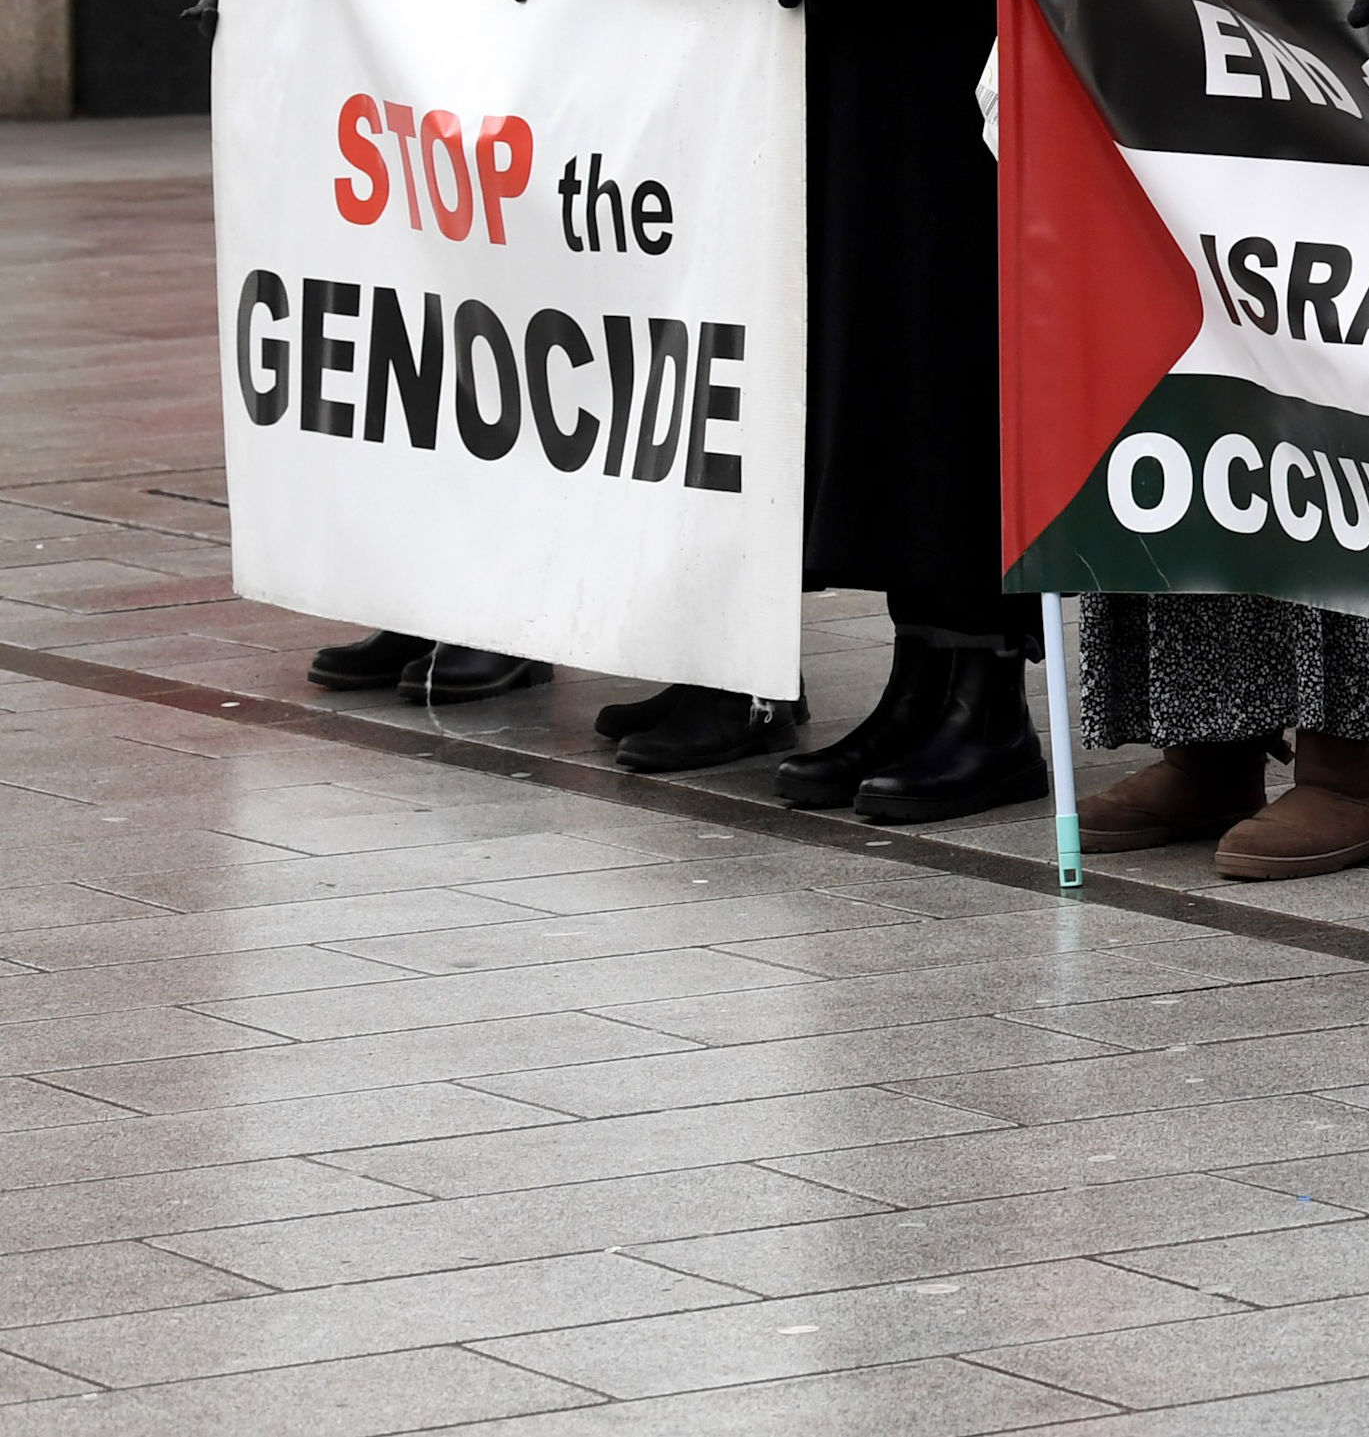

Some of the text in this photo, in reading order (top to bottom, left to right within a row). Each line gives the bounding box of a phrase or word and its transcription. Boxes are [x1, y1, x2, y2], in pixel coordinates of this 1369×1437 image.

[1192, 0, 1363, 120] END
[333, 92, 674, 256] STOP the
[236, 269, 746, 494] GENOCIDE
